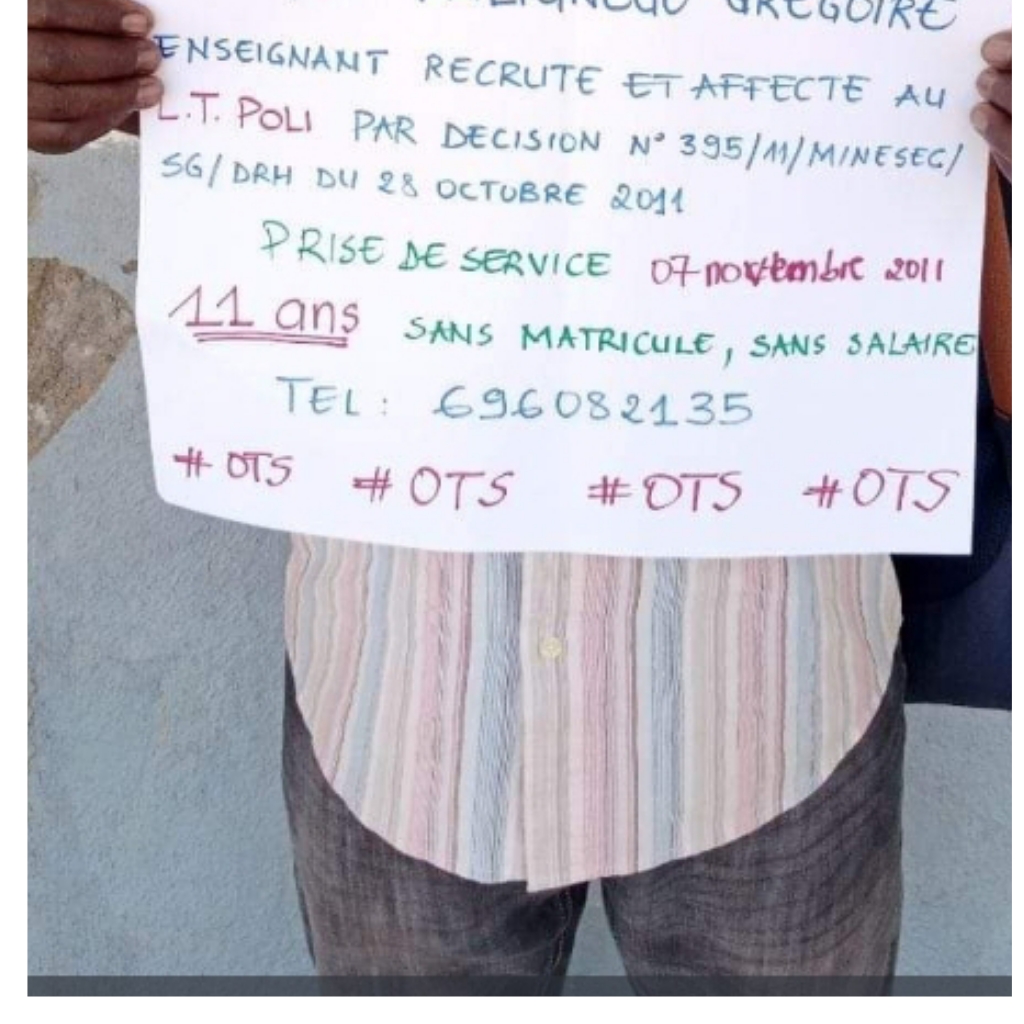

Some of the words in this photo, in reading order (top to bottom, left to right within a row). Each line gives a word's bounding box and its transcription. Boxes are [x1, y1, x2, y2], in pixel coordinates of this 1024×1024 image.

[152, 33, 389, 76] ENSEIGNANT
[424, 52, 602, 96] RECRUTE
[622, 72, 683, 99] ET
[690, 72, 870, 103] AFFECTE
[894, 84, 946, 110] AU
[237, 95, 312, 134] POLI
[354, 109, 417, 145] PAR
[440, 121, 601, 154] DECISION
[316, 167, 359, 189] DU
[377, 170, 418, 198] 28
[610, 182, 684, 216] 2011
[260, 219, 384, 266] PRISE
[397, 240, 446, 272] DE
[459, 246, 611, 278] SERVICE
[650, 254, 701, 288] 07
[883, 257, 944, 283] 2011
[168, 284, 255, 328] 11
[273, 298, 360, 334] ans
[403, 316, 494, 347] SANS
[749, 332, 826, 359] SANS
[846, 331, 978, 357] SALAIRE
[433, 385, 753, 427] 696082135
